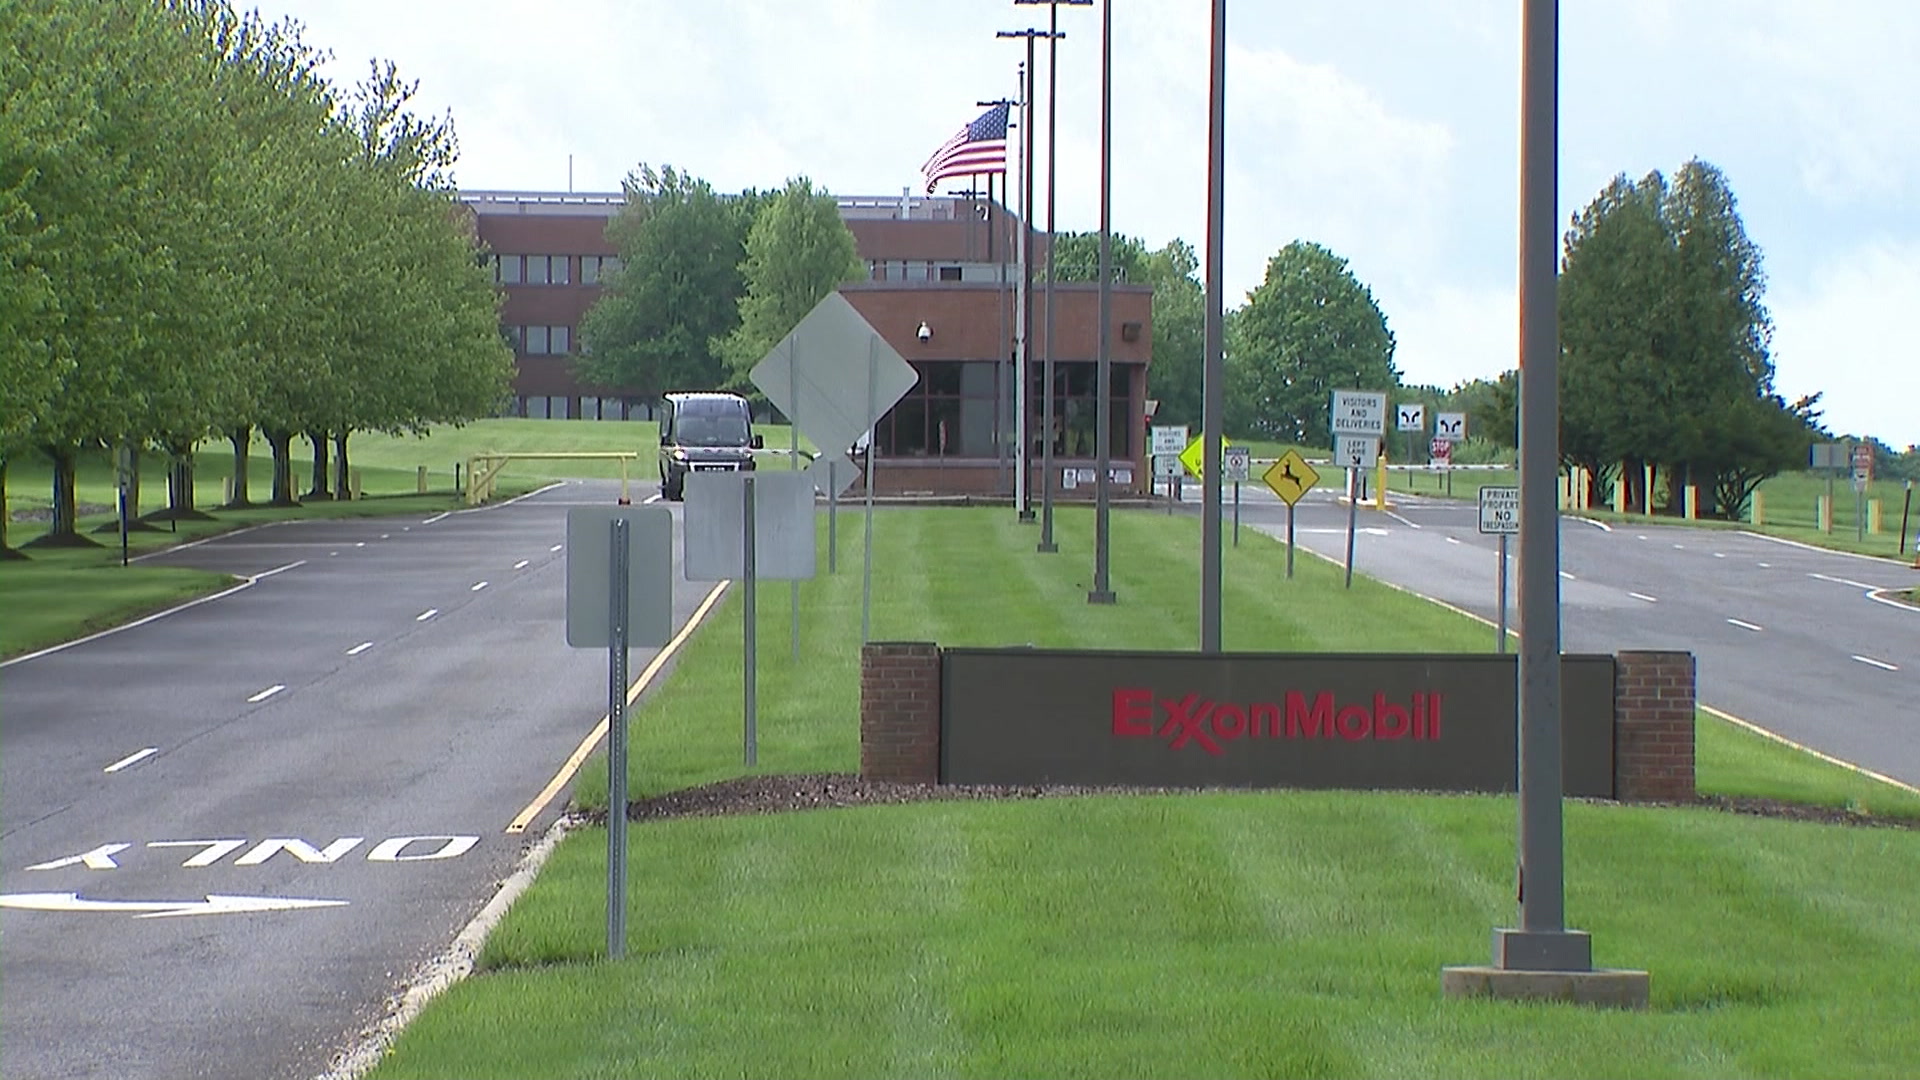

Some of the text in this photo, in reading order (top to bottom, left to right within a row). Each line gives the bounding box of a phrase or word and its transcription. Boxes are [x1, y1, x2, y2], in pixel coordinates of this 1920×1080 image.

[1342, 398, 1377, 408] VISITORS
[1351, 409, 1367, 418] AND
[1336, 418, 1381, 429] DELIVERIES
[1432, 441, 1450, 451] STOP
[1483, 500, 1519, 509] PROPERT
[1495, 511, 1511, 521] NO
[1483, 521, 1519, 529] TRESPASSIN
[1112, 689, 1442, 754] ExxonMobil
[26, 834, 480, 870] ONLY
